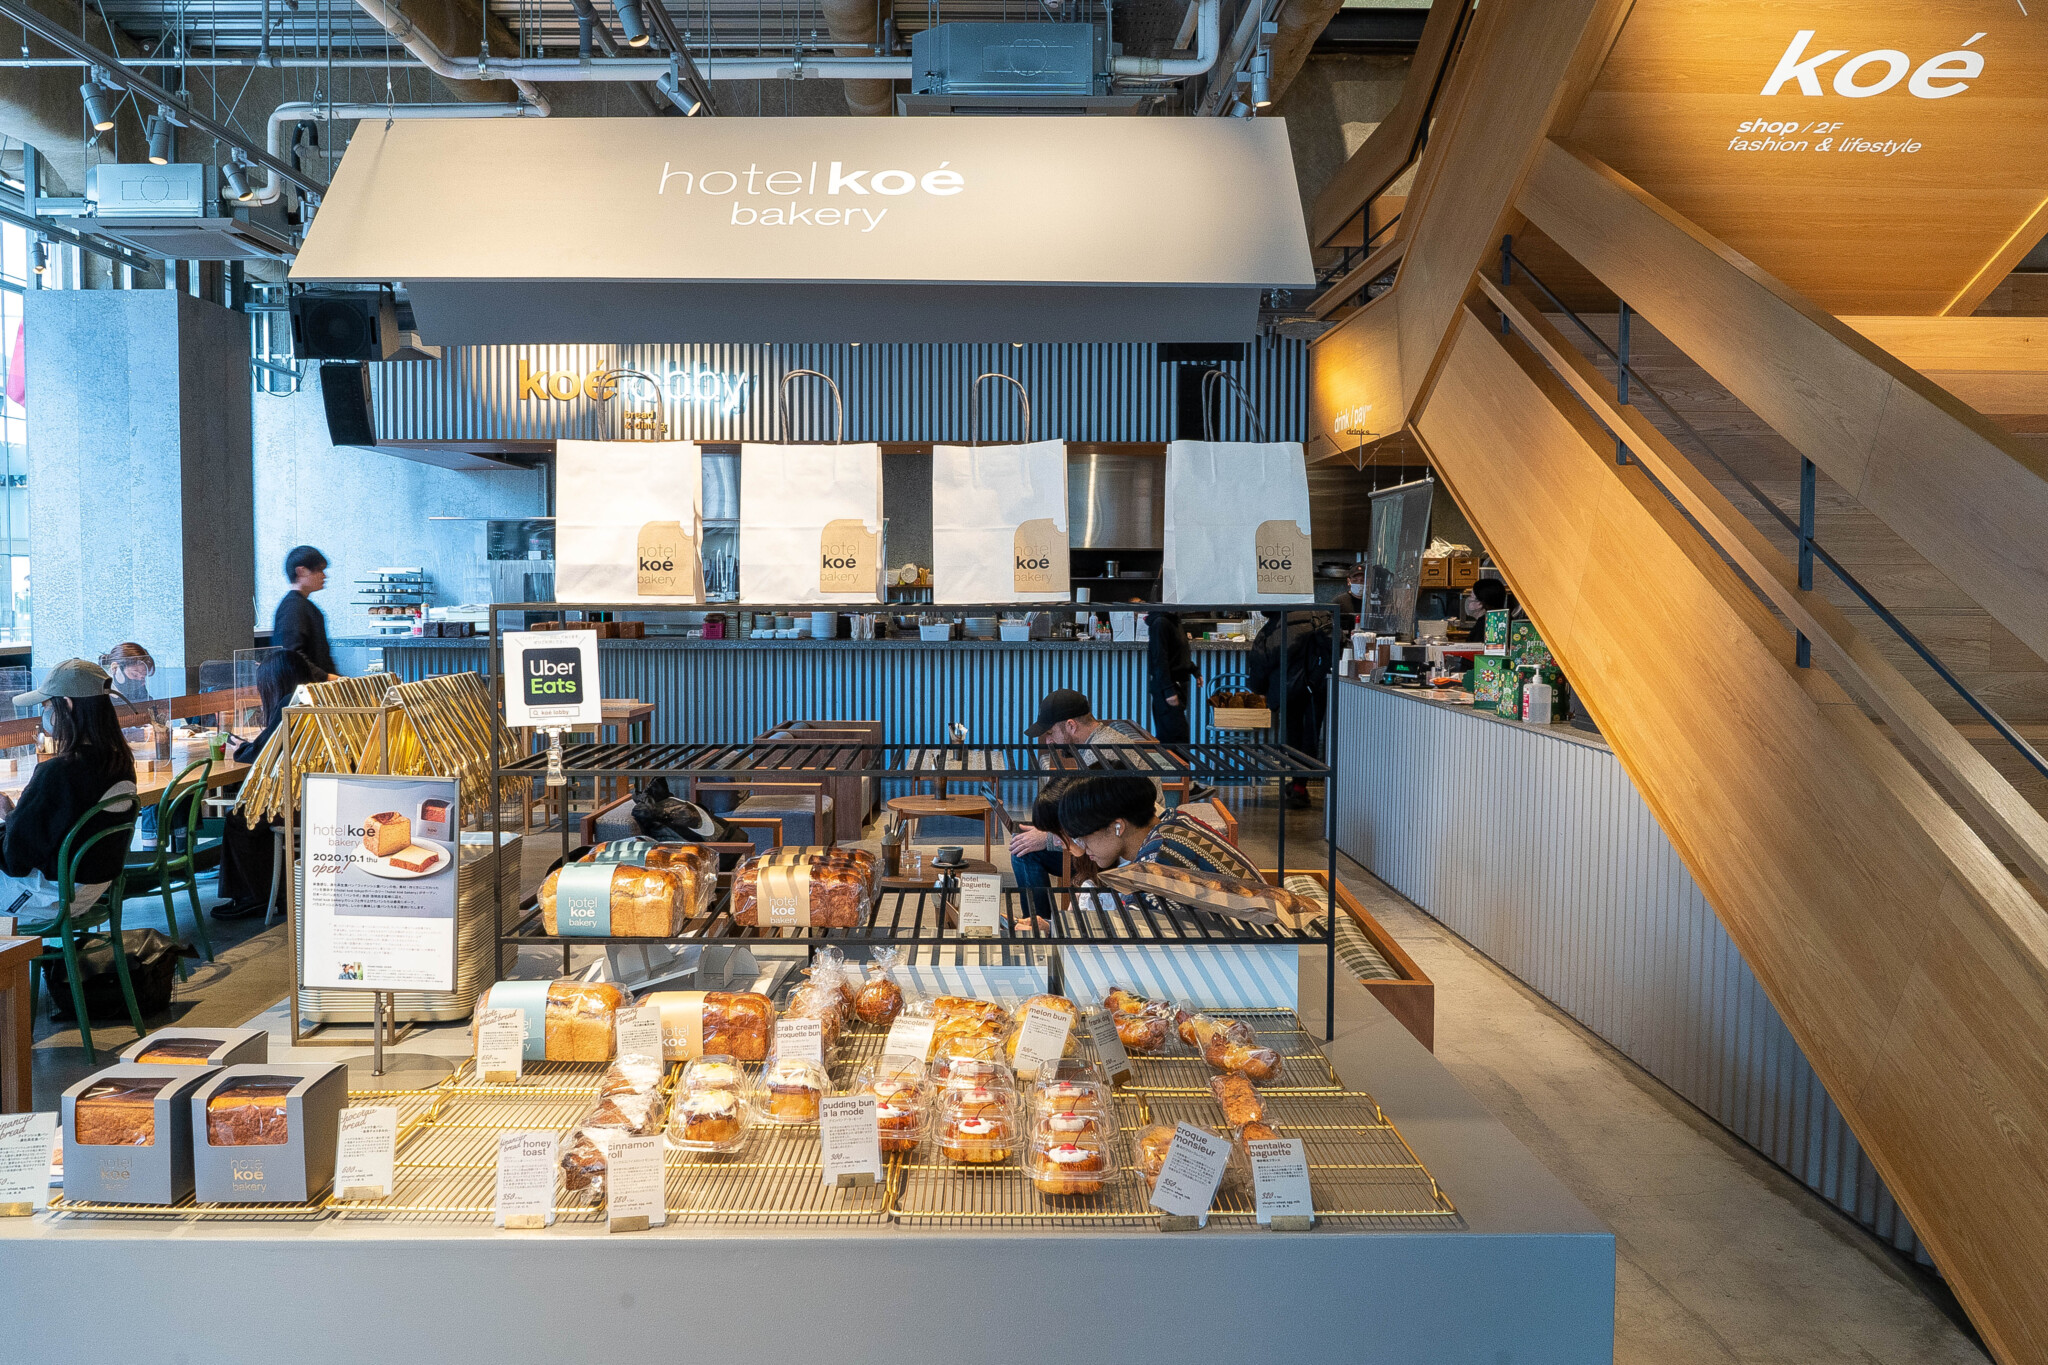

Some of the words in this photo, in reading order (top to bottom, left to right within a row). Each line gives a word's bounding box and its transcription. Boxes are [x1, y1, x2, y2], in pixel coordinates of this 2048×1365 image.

[1760, 30, 1987, 99] koé
[1736, 118, 1799, 136] shop
[1813, 122, 1844, 134] 2F
[1727, 136, 1808, 151] fashion
[1815, 138, 1834, 151] &
[1838, 138, 1922, 156] lifestyle
[658, 161, 817, 195] hotel
[828, 161, 964, 196] koé
[730, 201, 888, 233] bakery
[518, 359, 617, 401] koé
[622, 360, 752, 414] lobby
[624, 410, 655, 419] bread
[634, 420, 668, 433] dinig
[640, 556, 674, 571] koé
[822, 554, 856, 568] koé
[1016, 554, 1050, 569] koé
[1258, 556, 1292, 570] koé
[530, 660, 575, 676] Uber
[530, 678, 576, 694] Eats
[313, 824, 346, 836] hotel
[347, 824, 376, 837] koé
[328, 838, 360, 848] bakery
[313, 854, 364, 862] 2020.10.1
[312, 861, 351, 877] open!
[568, 896, 598, 908] hotel
[769, 896, 798, 906] hotel
[570, 905, 595, 918] koé
[772, 904, 796, 915] koé
[568, 918, 597, 928] bakery
[770, 917, 798, 926] bakery
[1030, 1007, 1052, 1018] melon
[1052, 1012, 1067, 1022] bun
[664, 1048, 689, 1057] akery
[823, 1100, 856, 1110] pudding
[840, 1108, 864, 1116] mode
[0, 1114, 36, 1130] inancier
[1176, 1126, 1208, 1144] croque
[523, 1140, 552, 1148] honey
[608, 1141, 654, 1150] cinnamon
[1174, 1134, 1216, 1157] monsieur
[1249, 1142, 1292, 1150] mentaiko
[523, 1148, 546, 1156] toast
[608, 1150, 622, 1158] roll
[1250, 1149, 1291, 1158] baguette
[231, 1158, 264, 1170] hote
[232, 1182, 266, 1194] bakery
